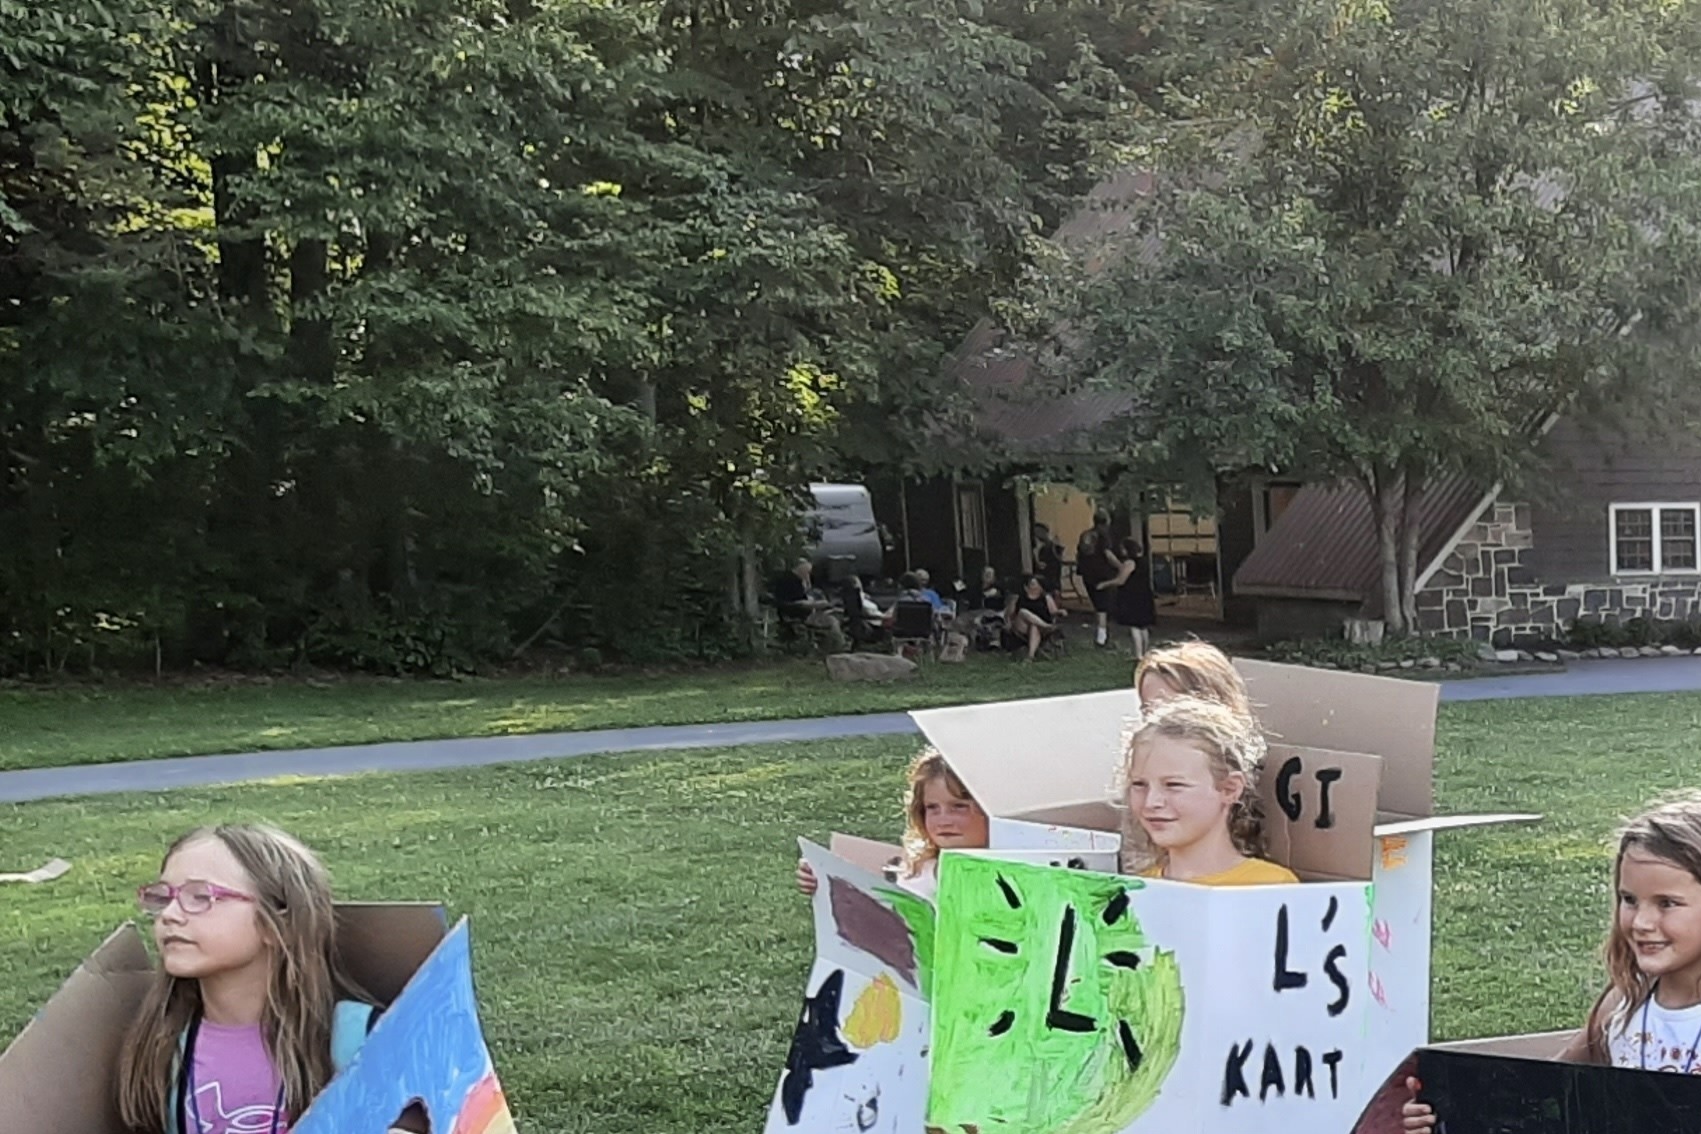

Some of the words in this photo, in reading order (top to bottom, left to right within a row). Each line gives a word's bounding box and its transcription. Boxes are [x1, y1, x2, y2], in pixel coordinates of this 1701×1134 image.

[1275, 756, 1342, 829] GI
[1045, 903, 1099, 1033] L
[1221, 1038, 1344, 1107] KART
